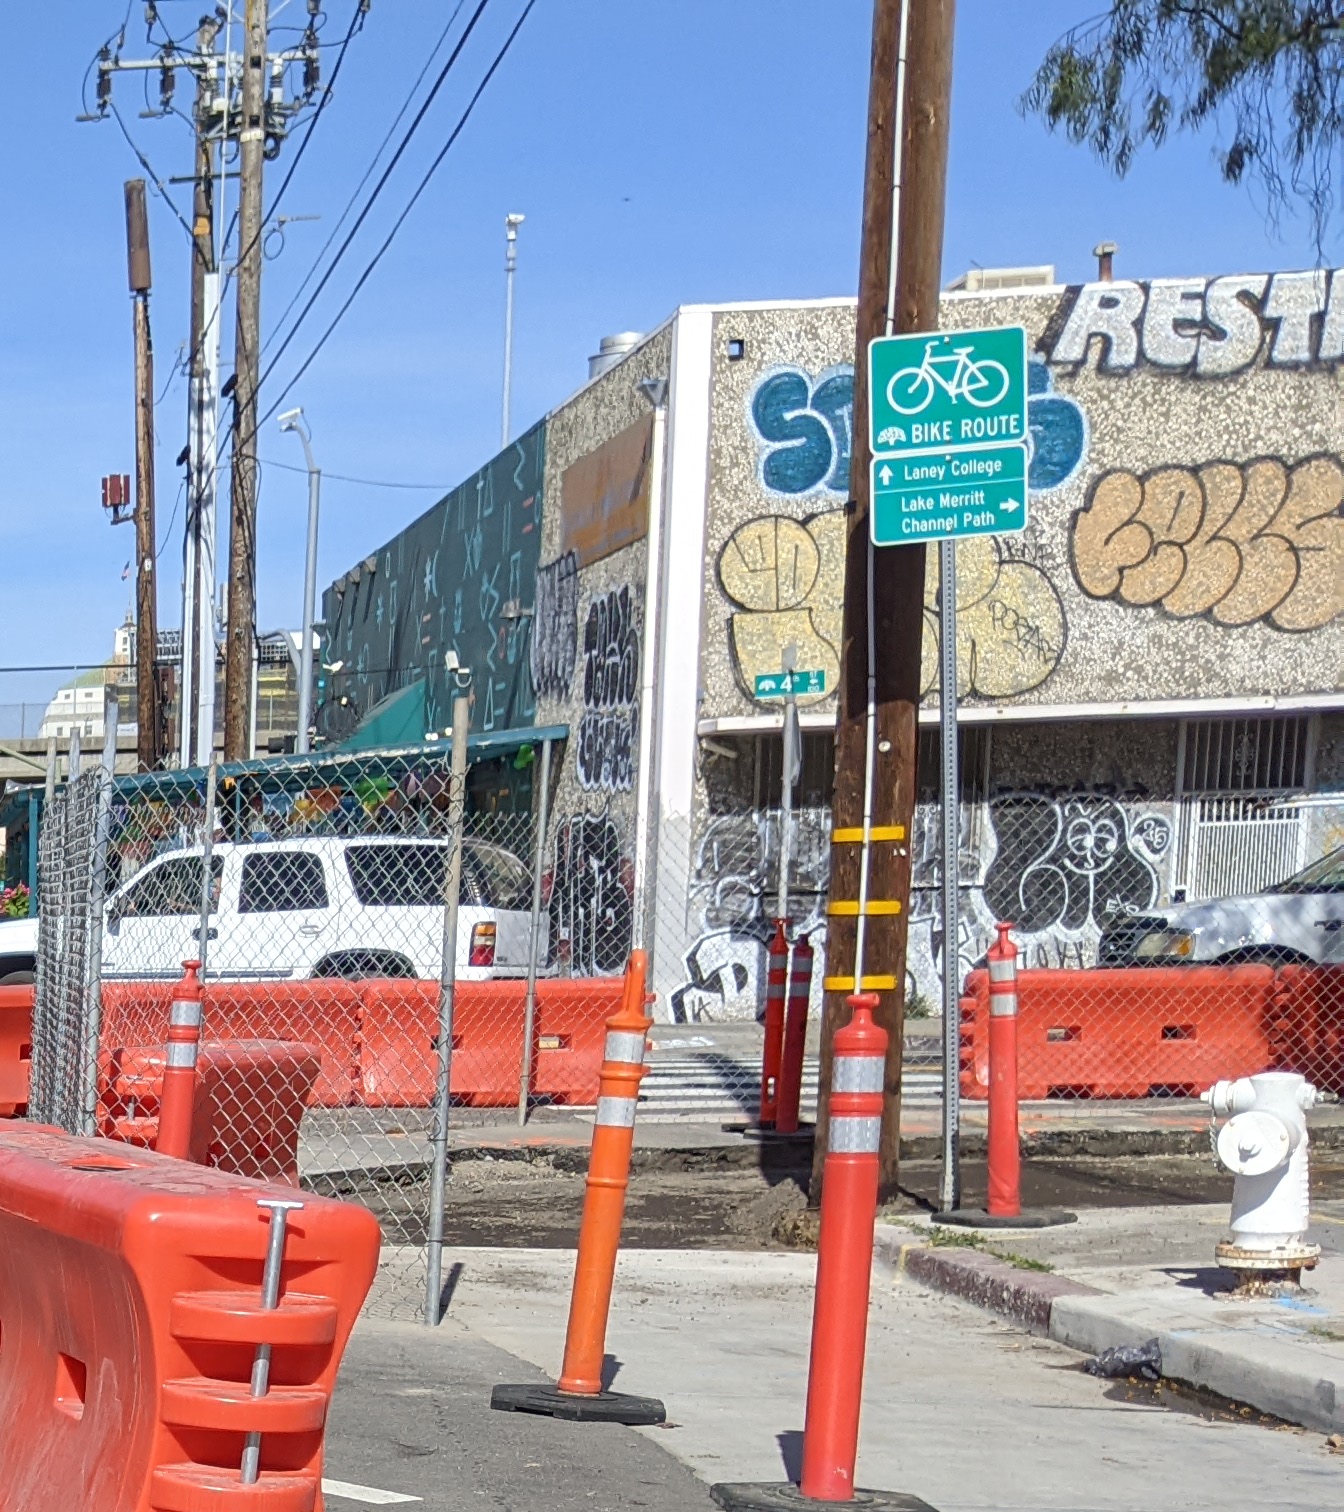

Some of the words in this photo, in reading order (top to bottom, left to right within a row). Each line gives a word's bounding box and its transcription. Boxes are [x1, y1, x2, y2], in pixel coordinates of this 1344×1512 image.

[912, 420, 952, 443] BIKE
[961, 414, 1020, 438] ROUTE
[904, 465, 945, 481] Laney
[951, 459, 1002, 477] College
[901, 496, 934, 512] Lake
[939, 490, 985, 508] Merritt
[901, 513, 957, 534] Channel
[963, 511, 995, 528] Path
